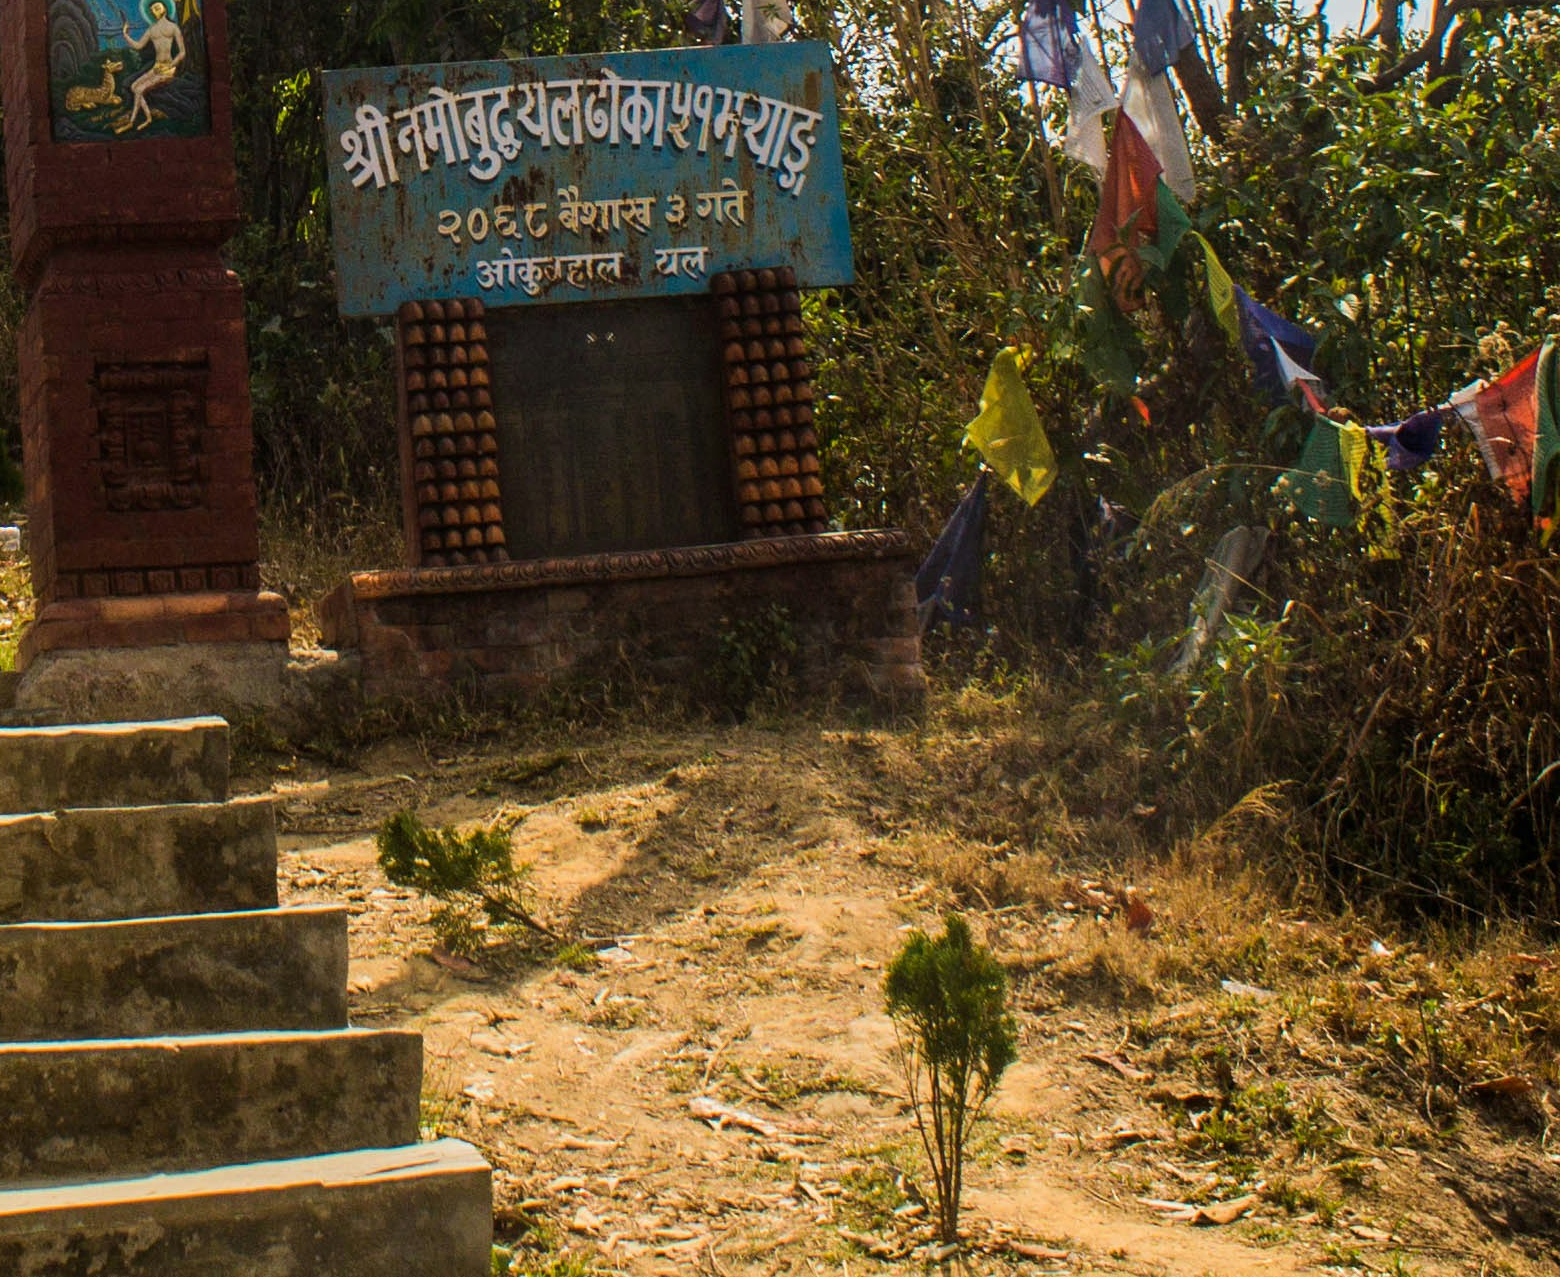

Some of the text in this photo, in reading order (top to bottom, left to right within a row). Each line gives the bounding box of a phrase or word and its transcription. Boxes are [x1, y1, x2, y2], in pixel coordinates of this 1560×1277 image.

[341, 105, 399, 188] श्री
[438, 202, 548, 244] २०६८
[666, 193, 686, 225] ३
[696, 178, 749, 226] गते
[654, 246, 709, 278] यल
